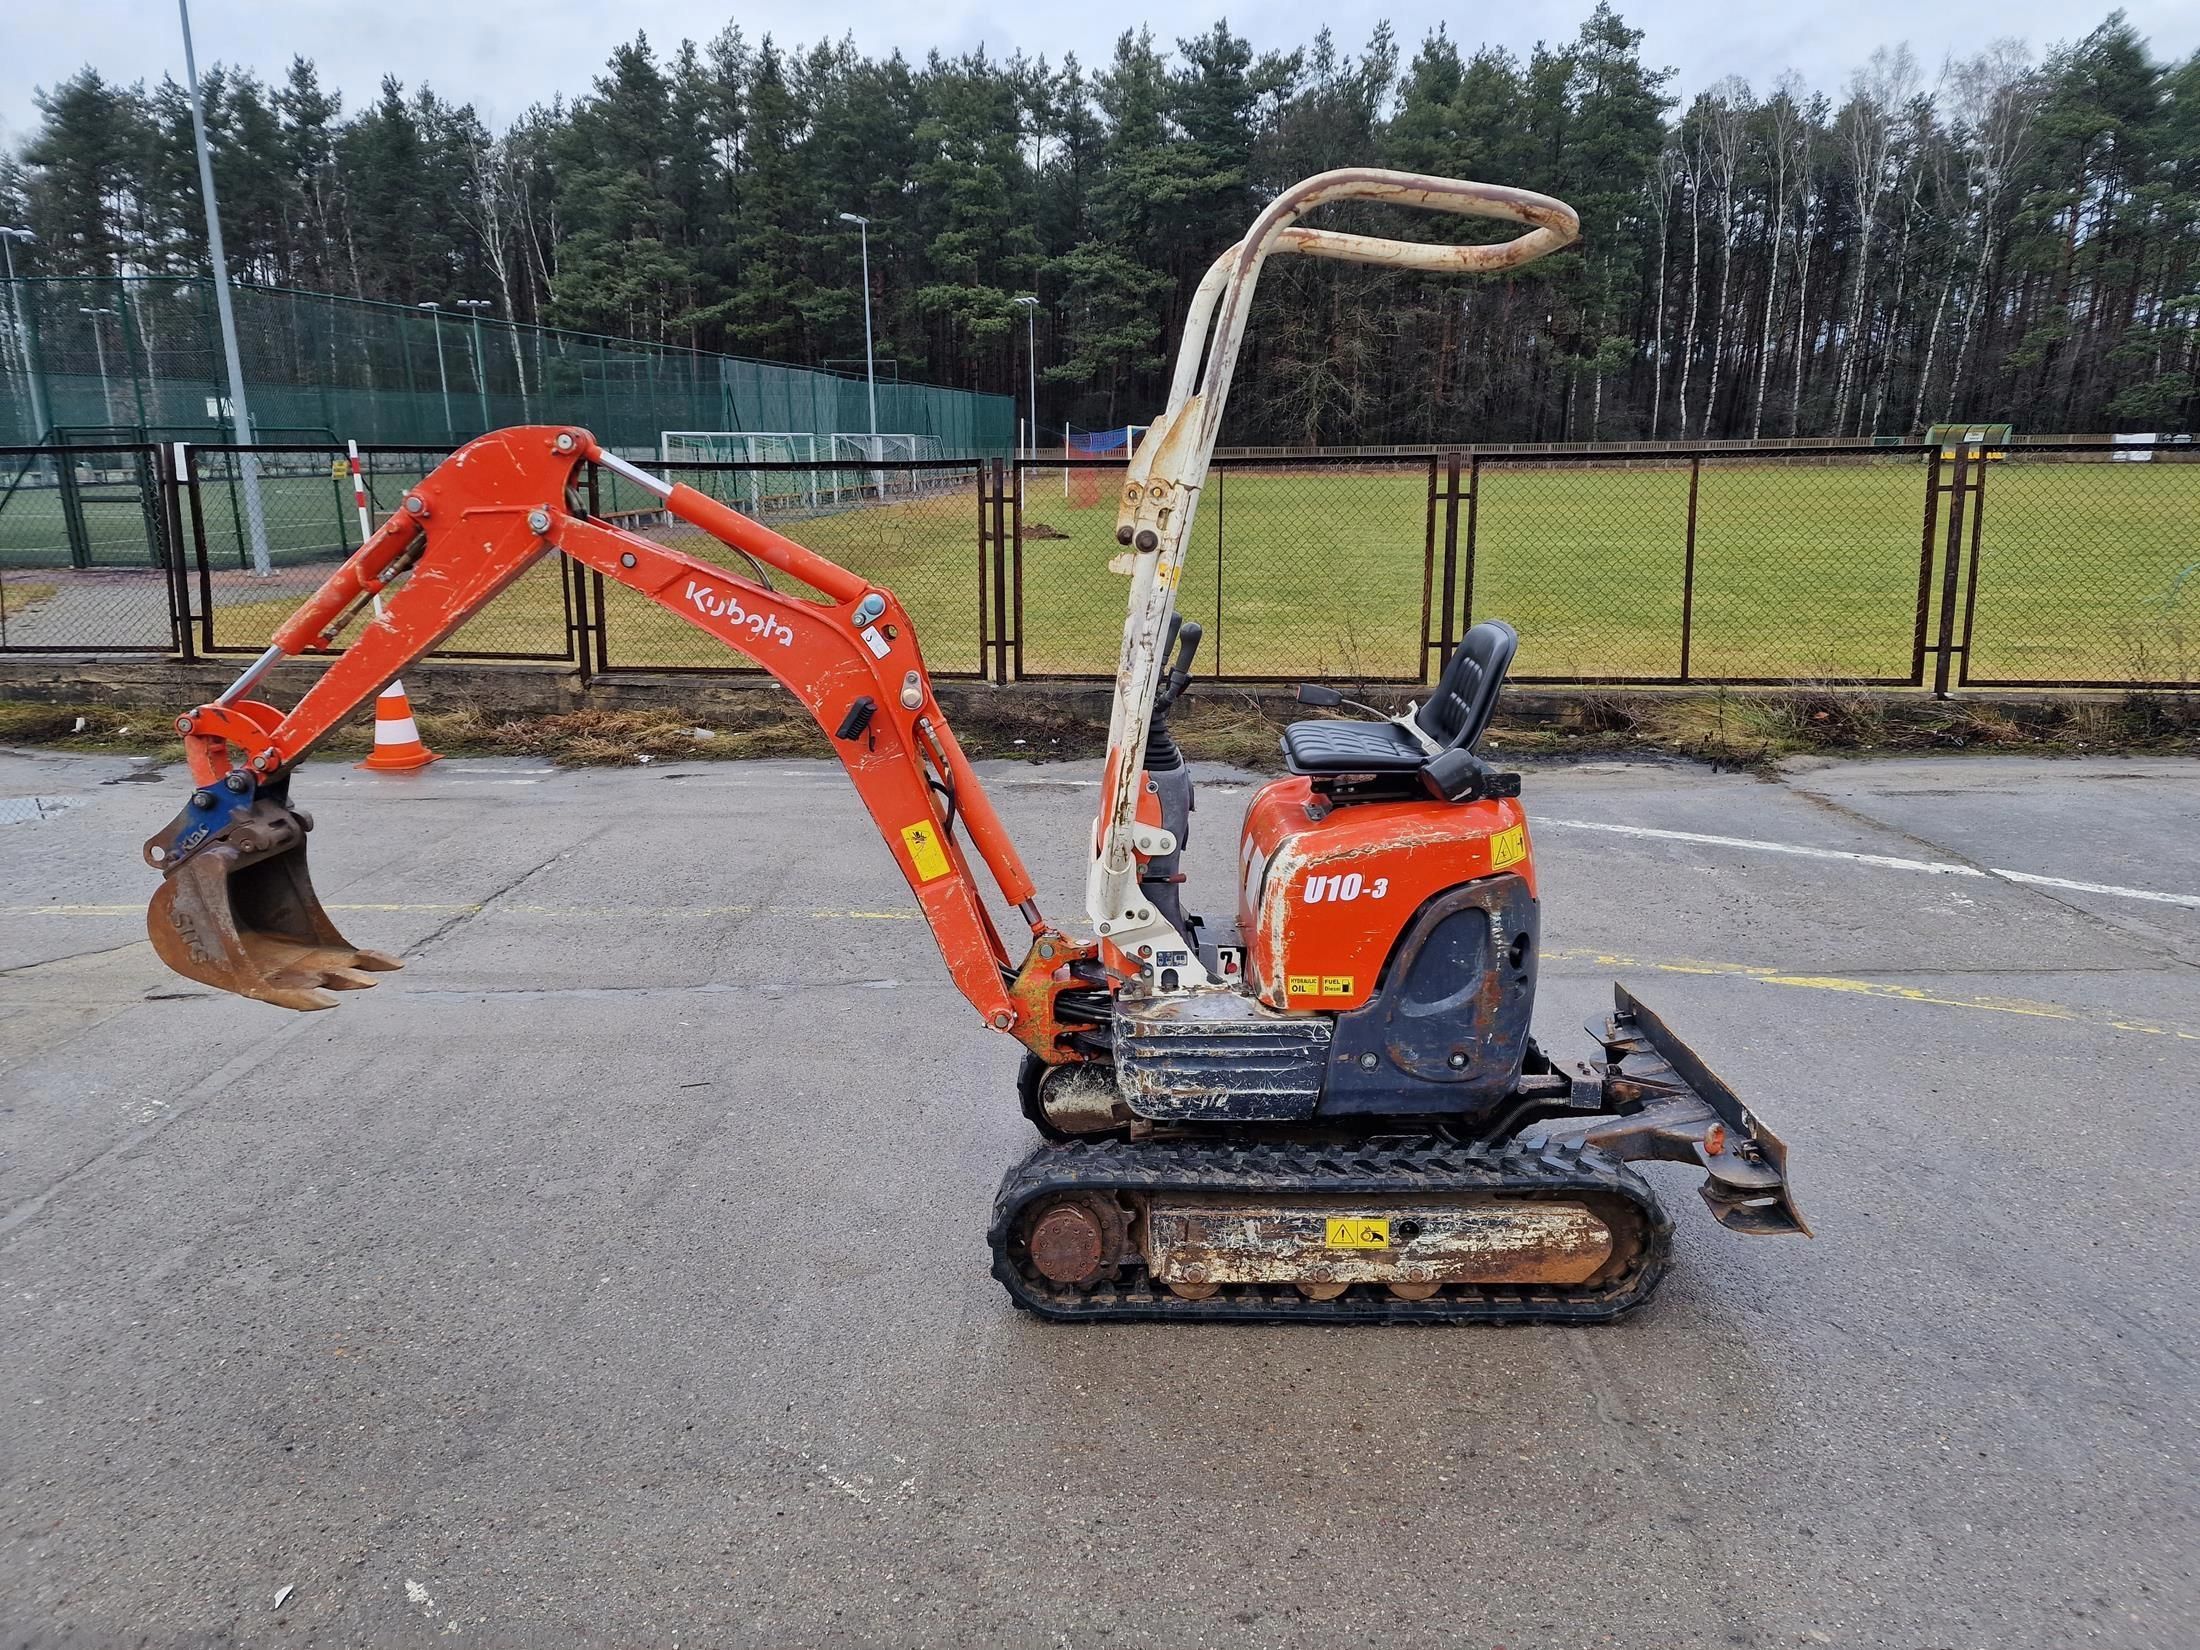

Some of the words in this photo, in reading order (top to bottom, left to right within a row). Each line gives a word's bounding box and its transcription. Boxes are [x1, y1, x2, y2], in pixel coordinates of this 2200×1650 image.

[685, 581, 794, 647] Kubota
[1303, 873, 1389, 904] U10-3
[1291, 984, 1307, 993] OIL
